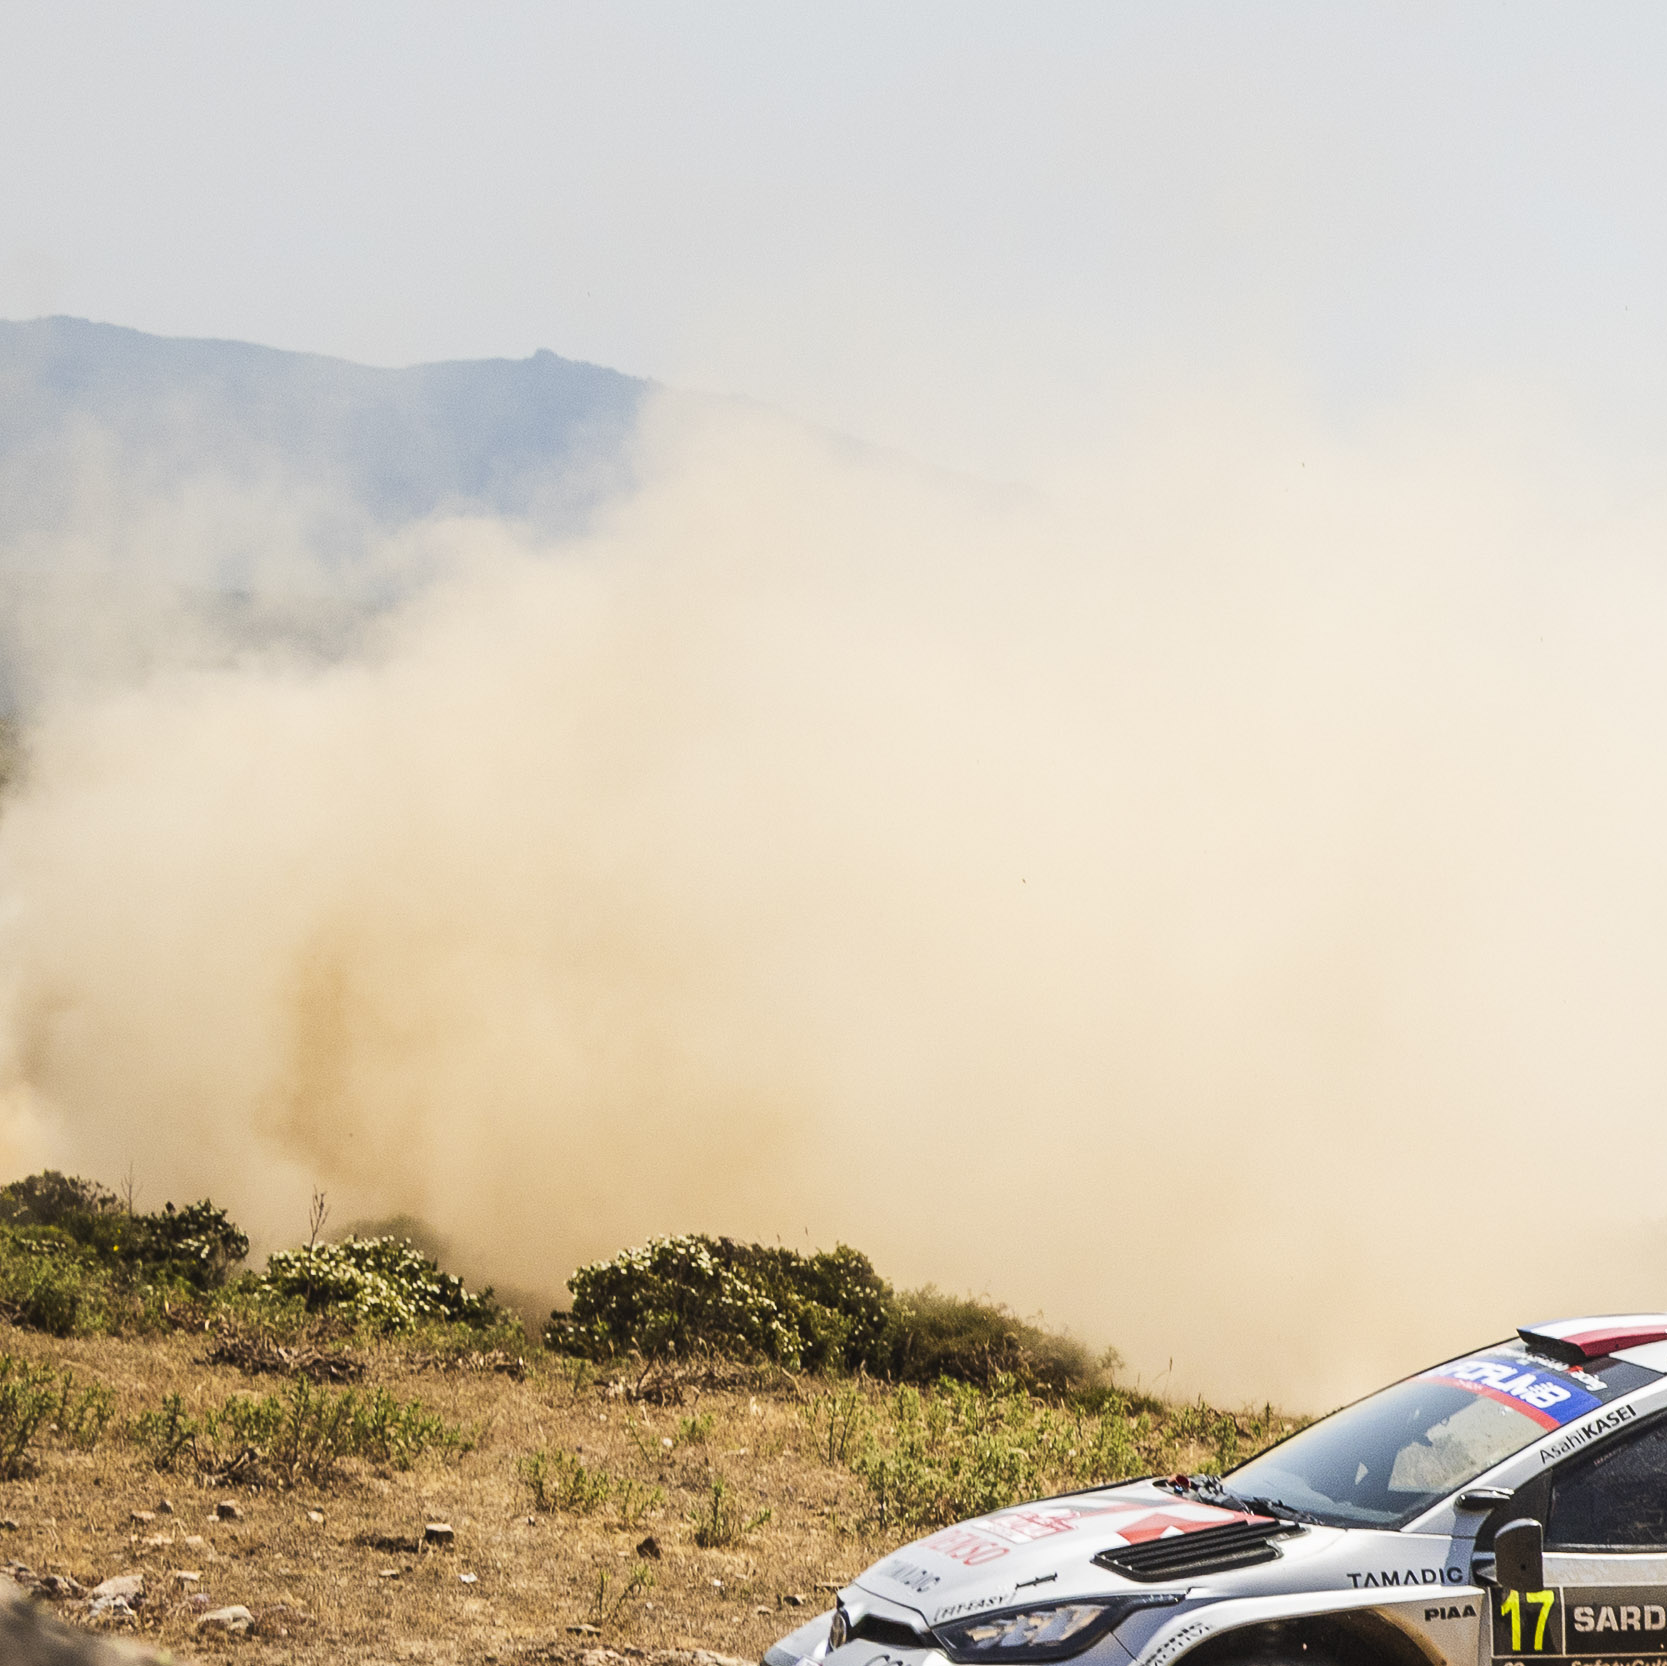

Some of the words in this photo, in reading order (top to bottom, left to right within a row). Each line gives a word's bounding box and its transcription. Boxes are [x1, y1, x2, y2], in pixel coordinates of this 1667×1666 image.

[1346, 1567, 1463, 1589] TAMADIC
[1424, 1604, 1477, 1622] PIAA
[1500, 1589, 1555, 1652] 17
